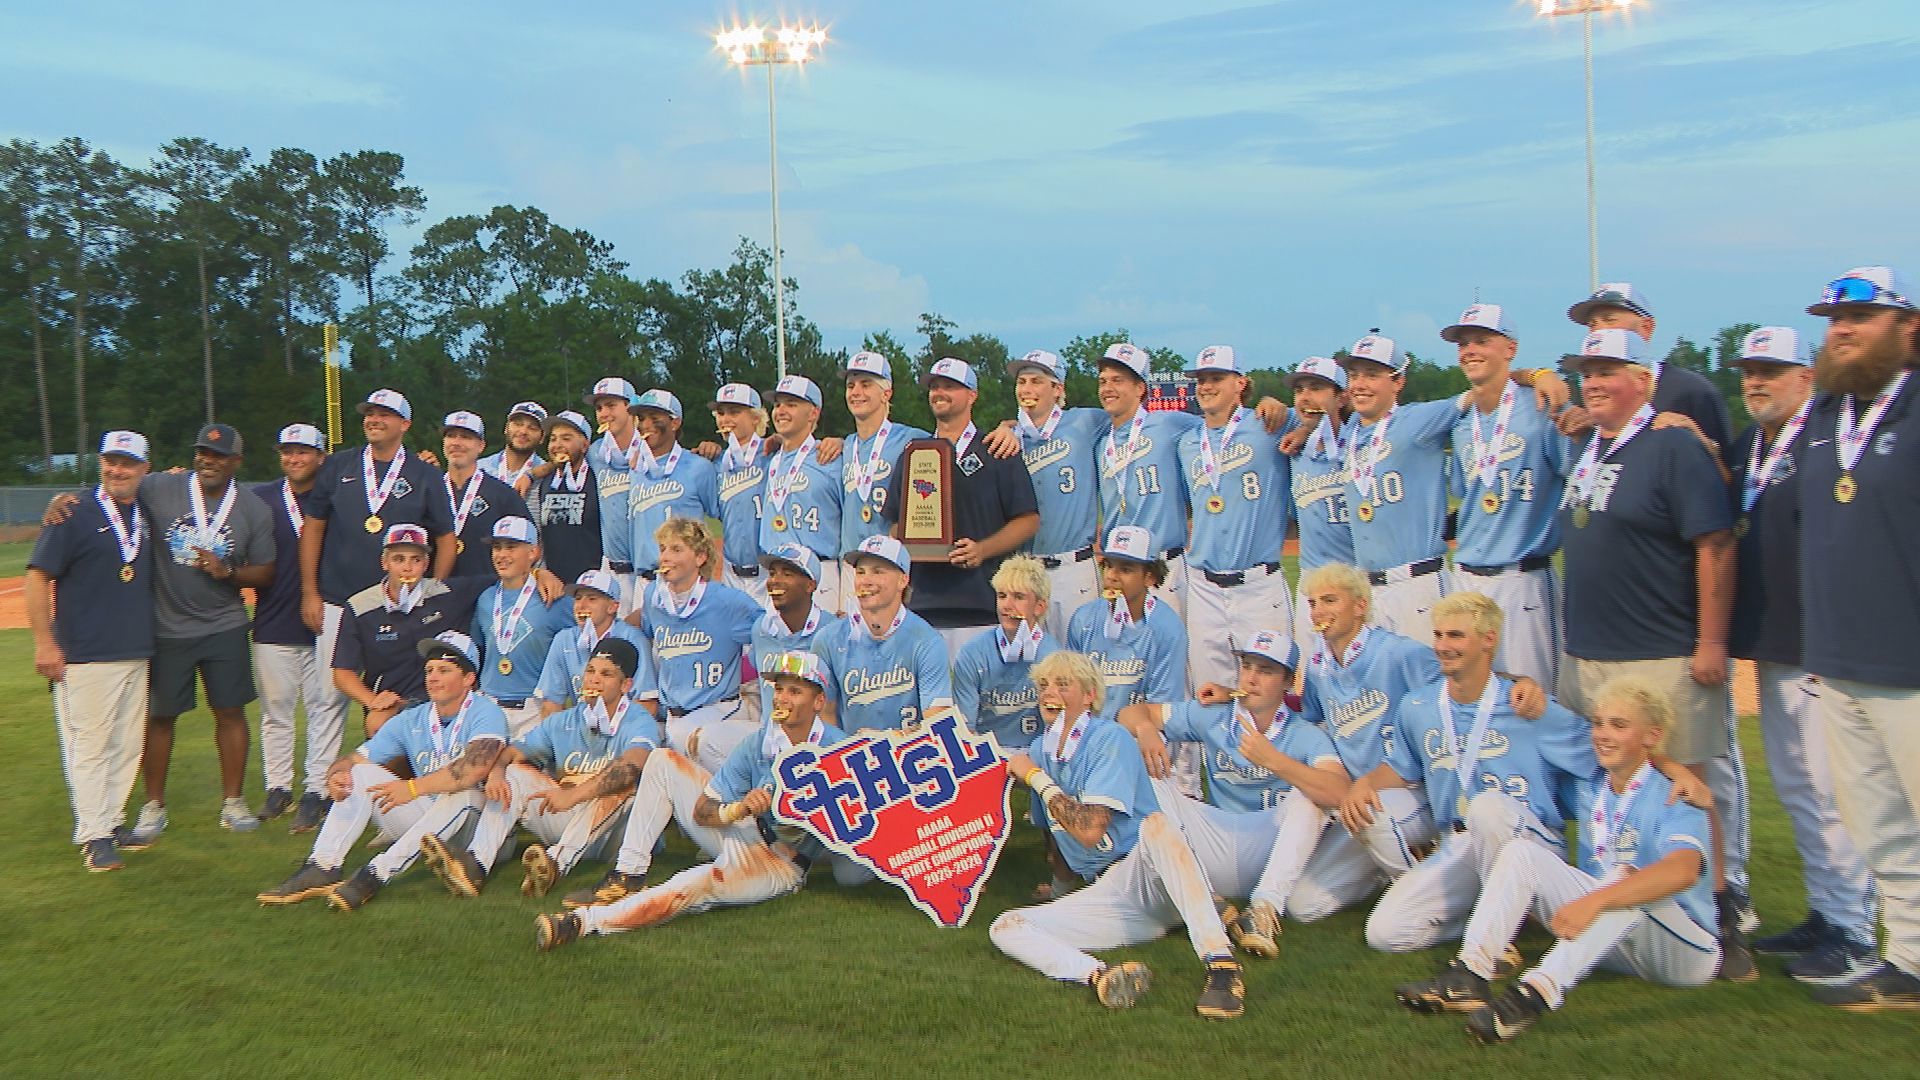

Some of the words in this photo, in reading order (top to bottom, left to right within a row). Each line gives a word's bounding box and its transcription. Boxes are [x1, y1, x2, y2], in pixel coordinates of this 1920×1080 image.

[599, 470, 630, 494] Chap
[1059, 466, 1076, 493] 3
[1136, 464, 1161, 496] 11
[1241, 471, 1261, 500] 8
[1371, 471, 1404, 507] 10
[1498, 468, 1534, 502] 14
[542, 494, 586, 508] JESUS
[628, 478, 684, 512] Chapin
[872, 486, 888, 512] 9
[792, 503, 819, 531] 24
[654, 626, 712, 656] Chapin
[693, 662, 722, 688] 18
[843, 663, 915, 699] Chapin
[901, 706, 917, 729] 2
[1020, 717, 1039, 733] 6
[779, 716, 997, 844] SCHSL
[888, 839, 939, 870] BASEBALL
[937, 817, 984, 847] DIVISION
[983, 813, 994, 827] II
[917, 815, 953, 840] AAAAA
[900, 857, 933, 881] STATE
[931, 832, 994, 867] CHAMPIONS
[923, 853, 983, 888] 2025-2026
